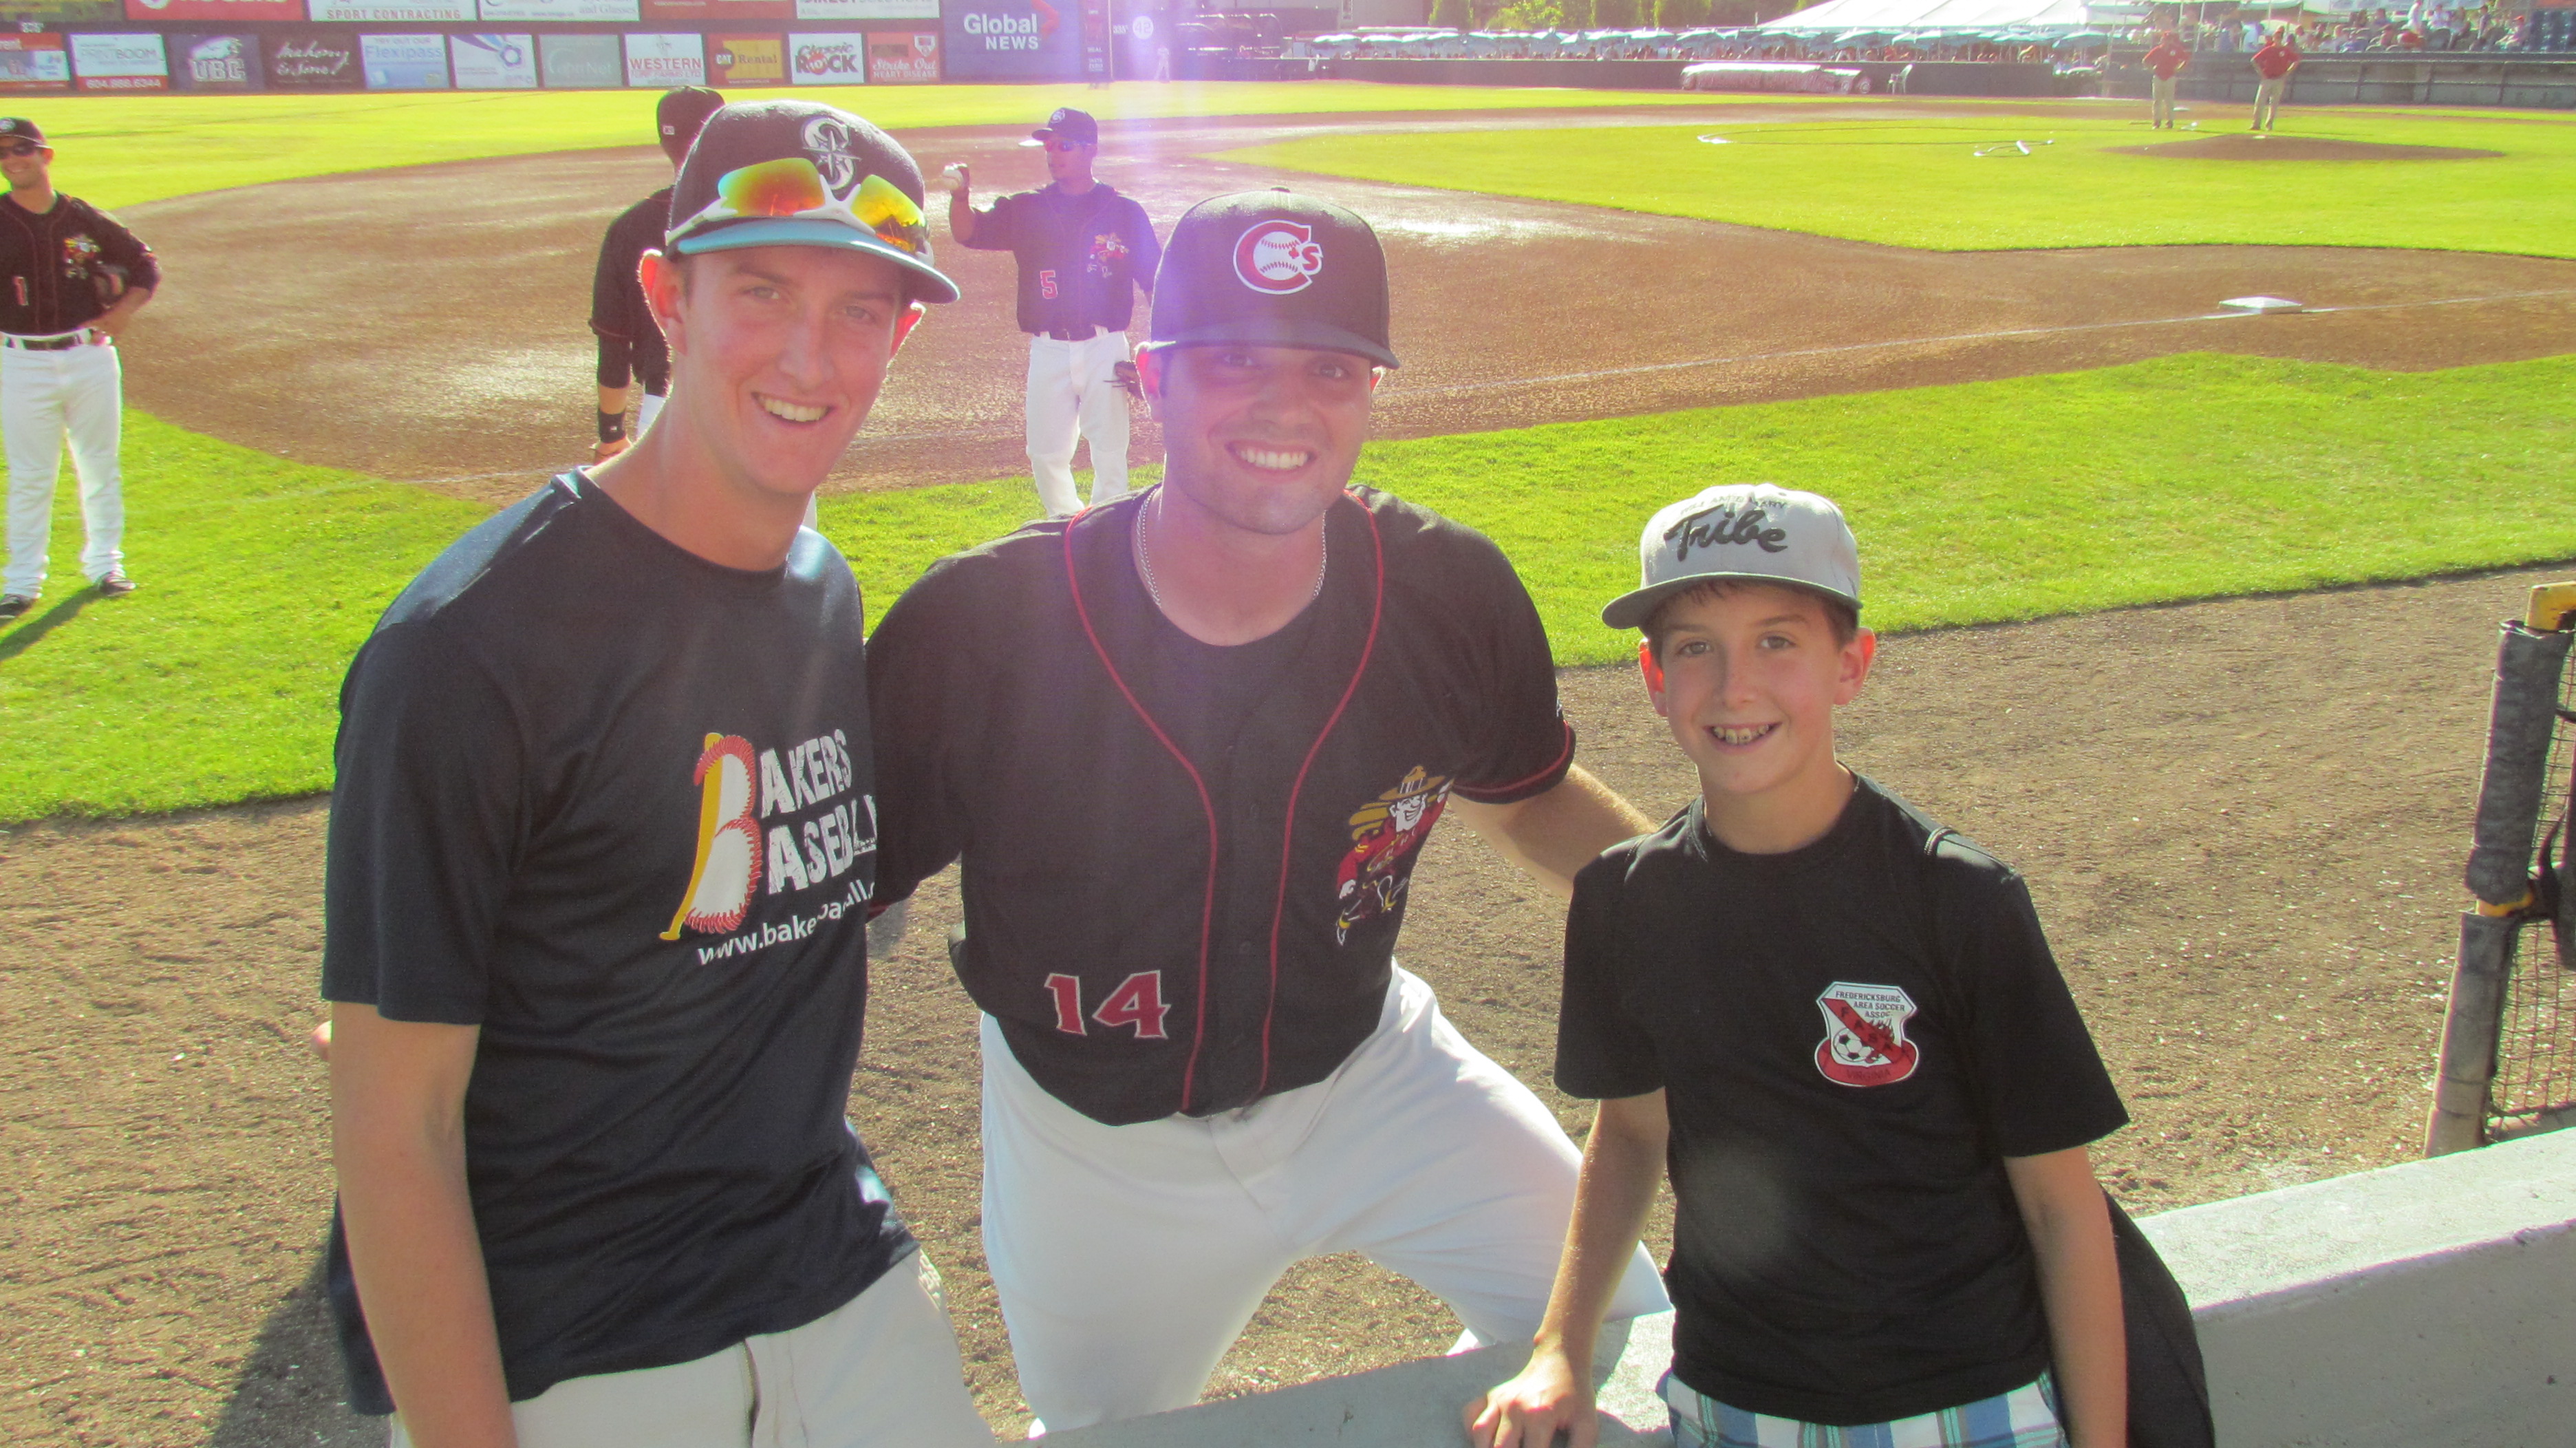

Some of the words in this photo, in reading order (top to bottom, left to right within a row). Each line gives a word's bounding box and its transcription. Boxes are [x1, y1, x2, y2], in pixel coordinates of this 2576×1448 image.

[327, 9, 367, 20] SPORT
[374, 9, 461, 20] CONTRACTING
[964, 13, 1038, 34] Global
[1135, 21, 1152, 34] 42
[985, 36, 1040, 50] NEWS
[365, 45, 442, 61] Flexipass
[716, 54, 732, 65] CAT
[190, 58, 246, 82] UBC
[629, 57, 702, 70] WESTERN
[1040, 269, 1058, 299] 5
[1663, 503, 1788, 562] Tribe
[1835, 990, 1901, 1003] FREDERICKSBURG
[1044, 969, 1172, 1040] 14
[1853, 1001, 1874, 1010] AREA
[1874, 1002, 1905, 1012] SOCCER
